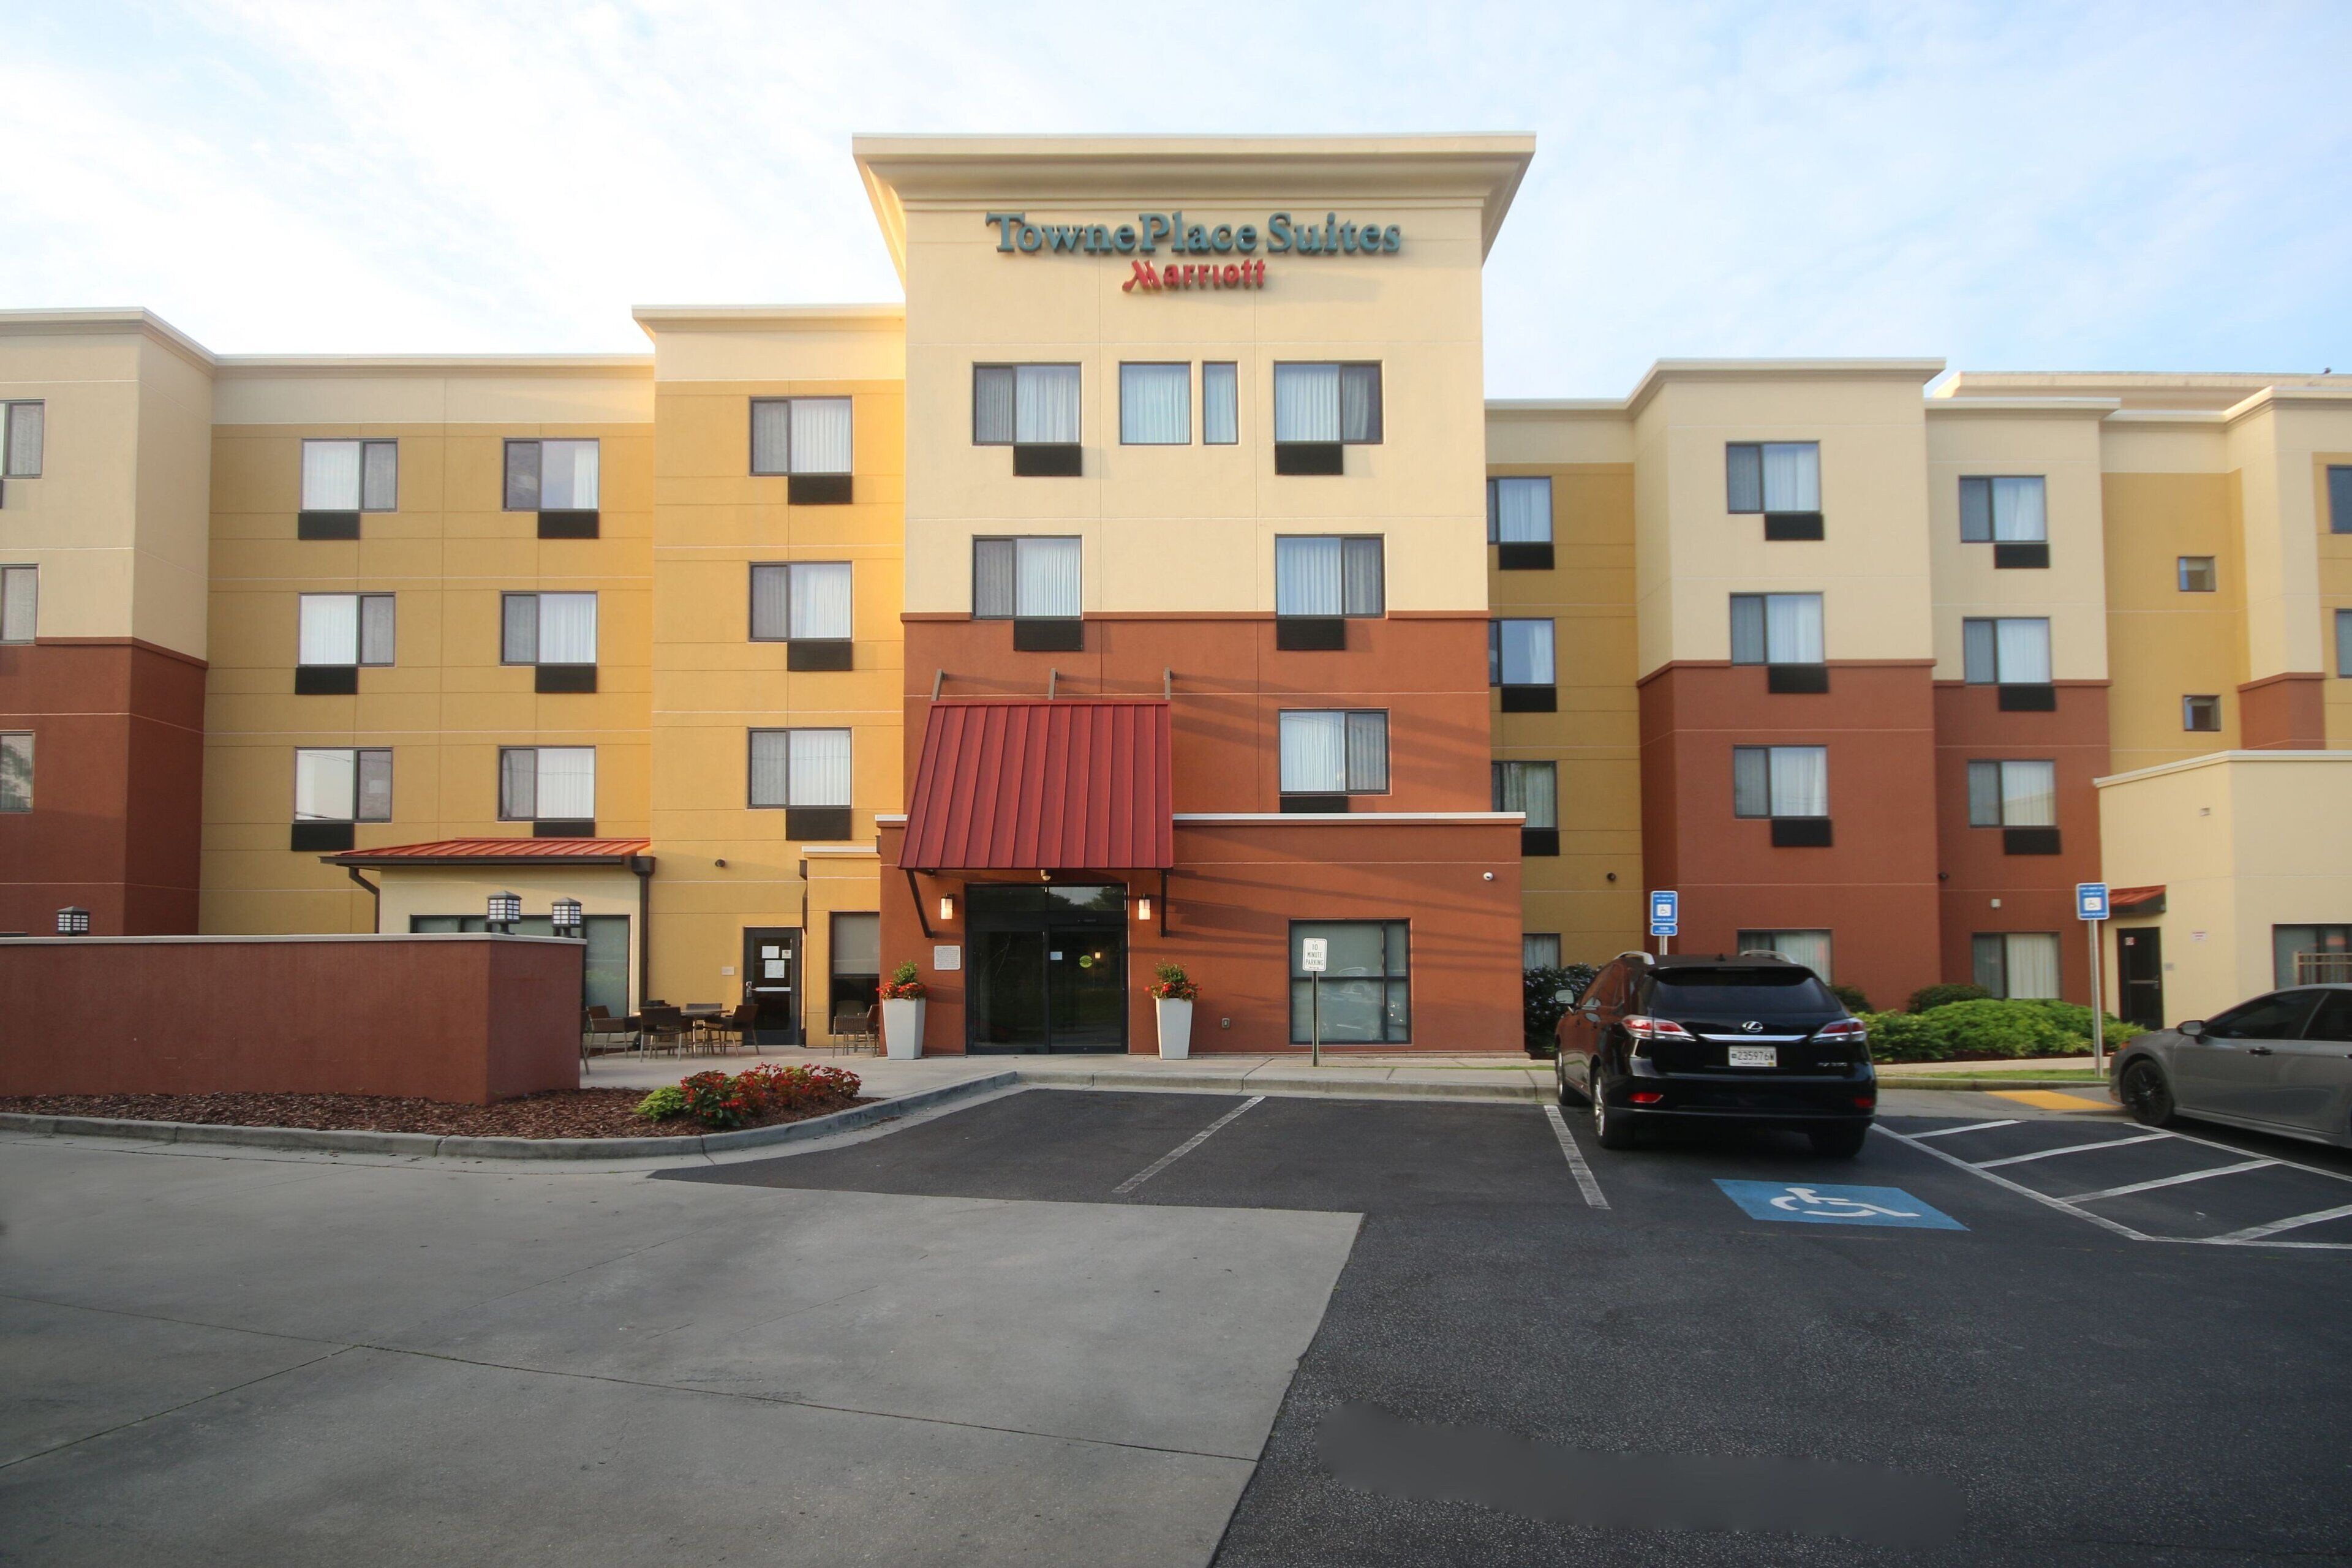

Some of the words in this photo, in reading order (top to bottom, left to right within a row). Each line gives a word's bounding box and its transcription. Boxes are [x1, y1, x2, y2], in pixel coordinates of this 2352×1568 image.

[985, 210, 1257, 255] TownePlace
[1266, 211, 1401, 254] Suites
[1121, 258, 1266, 292] Marriott
